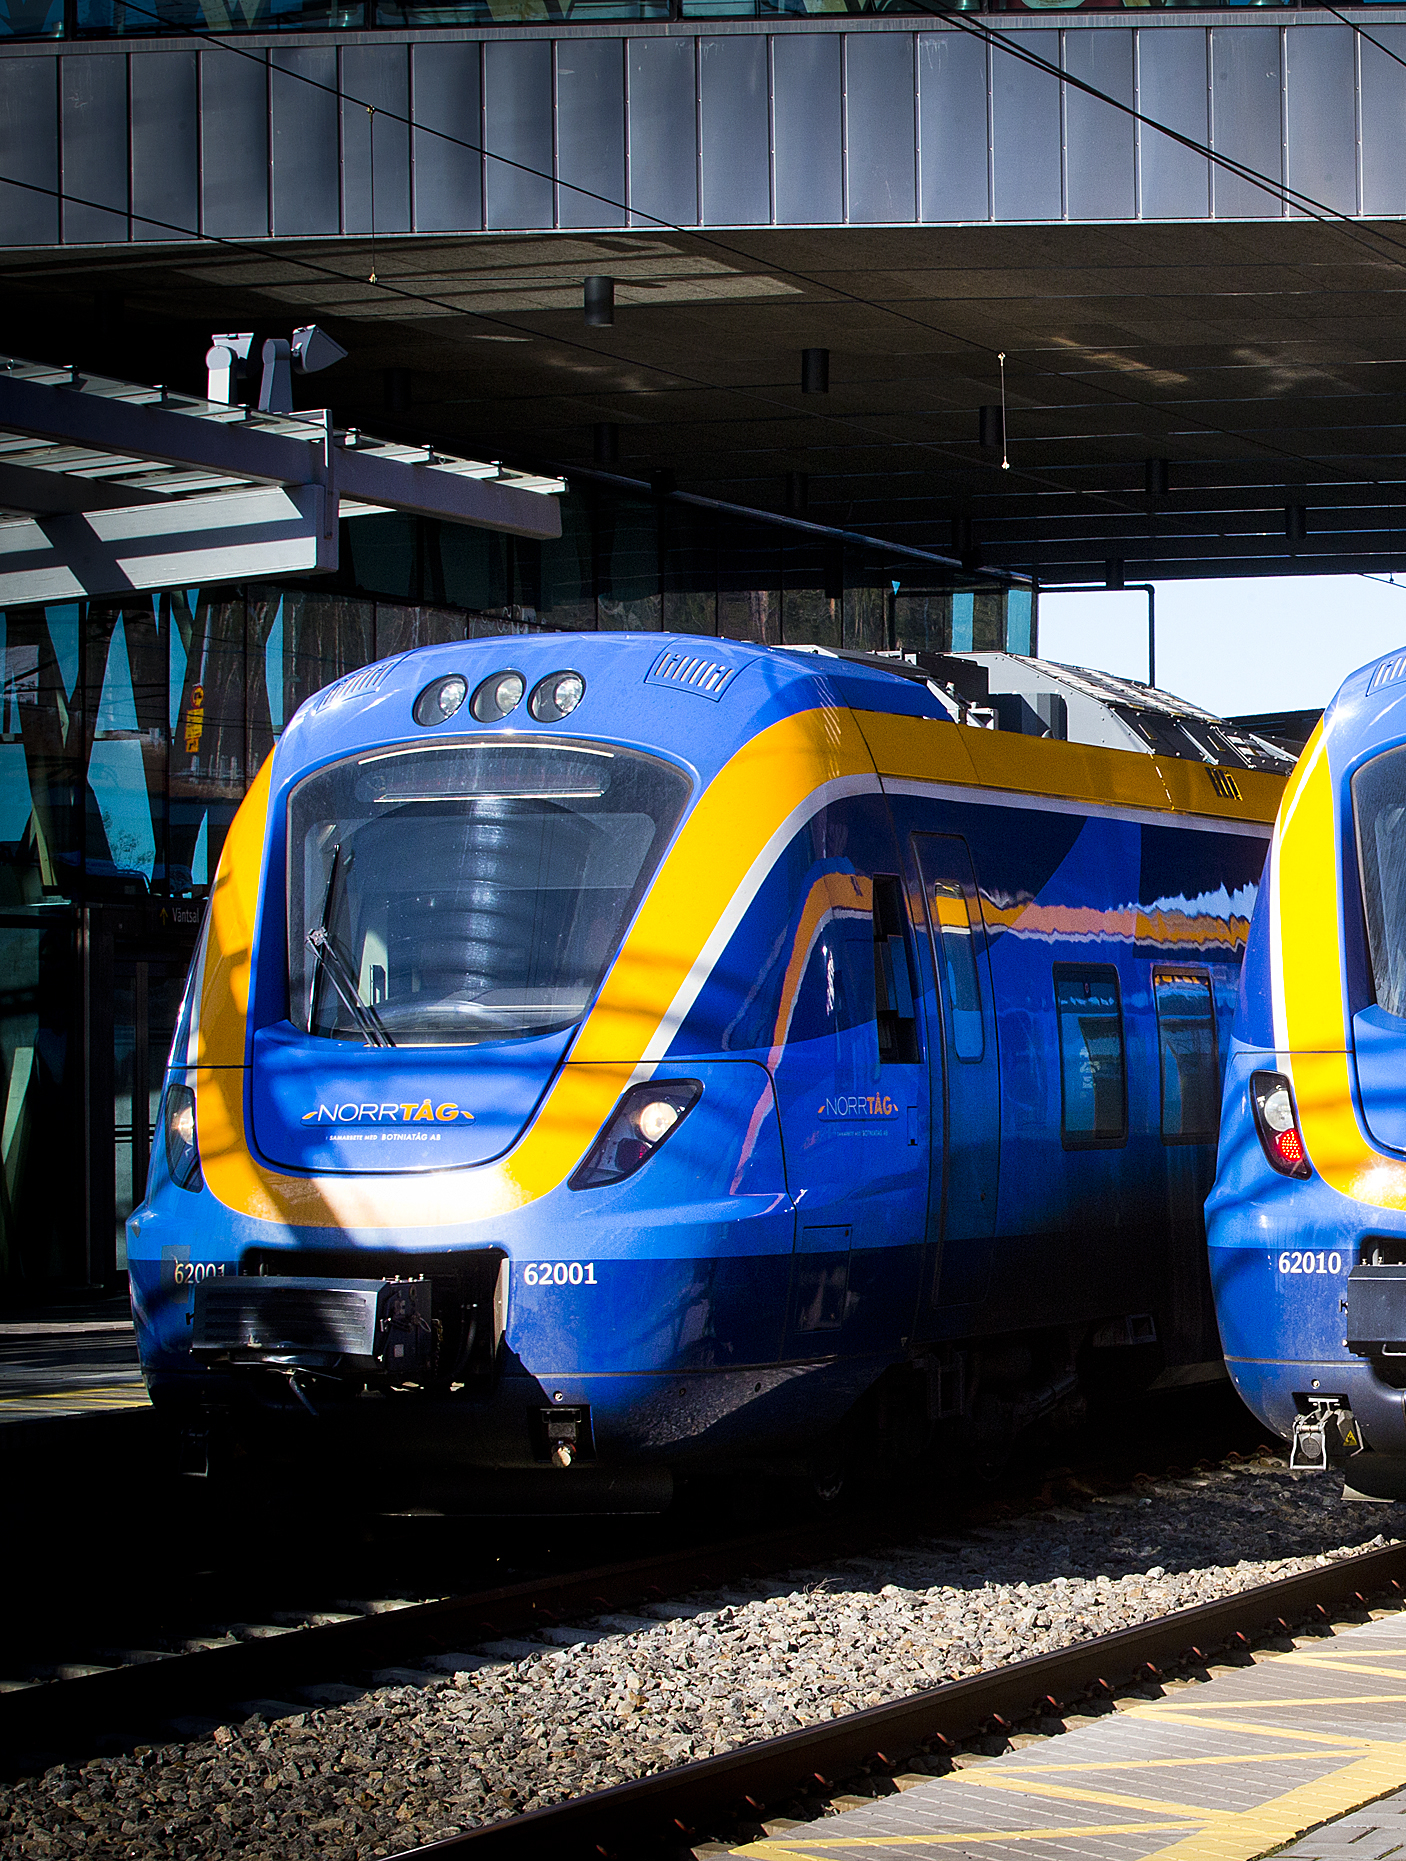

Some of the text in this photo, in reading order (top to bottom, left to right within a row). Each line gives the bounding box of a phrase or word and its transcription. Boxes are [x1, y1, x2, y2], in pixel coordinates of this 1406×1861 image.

[317, 1099, 460, 1122] NORRTÅG
[825, 1092, 892, 1115] NORRTÅG
[429, 1133, 441, 1141] AB
[524, 1262, 598, 1285] 62001
[1278, 1251, 1342, 1274] 62010
